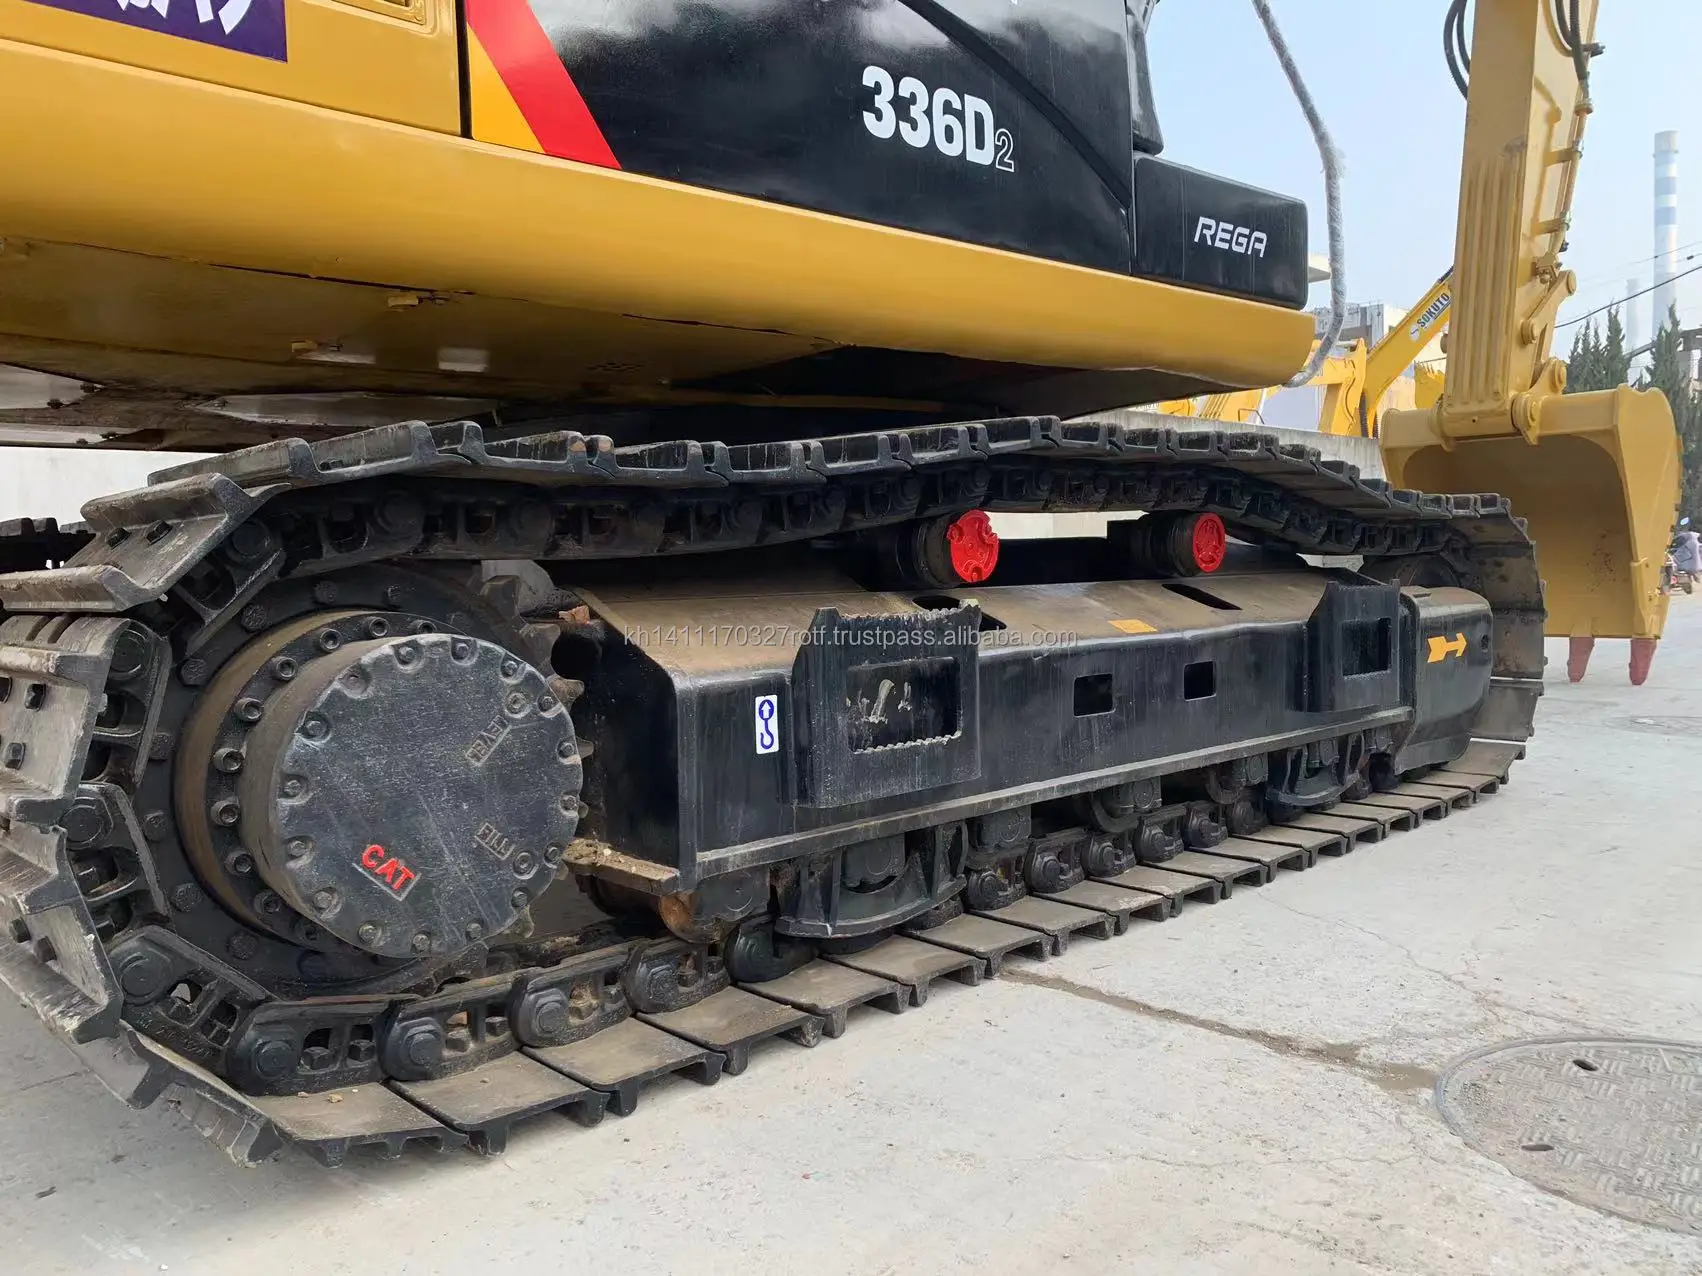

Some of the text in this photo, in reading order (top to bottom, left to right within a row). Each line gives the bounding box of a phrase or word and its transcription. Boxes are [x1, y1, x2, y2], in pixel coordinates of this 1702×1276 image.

[1194, 216, 1267, 257] REGA
[1417, 292, 1450, 328] SOKUTO
[362, 844, 416, 890] CAT
